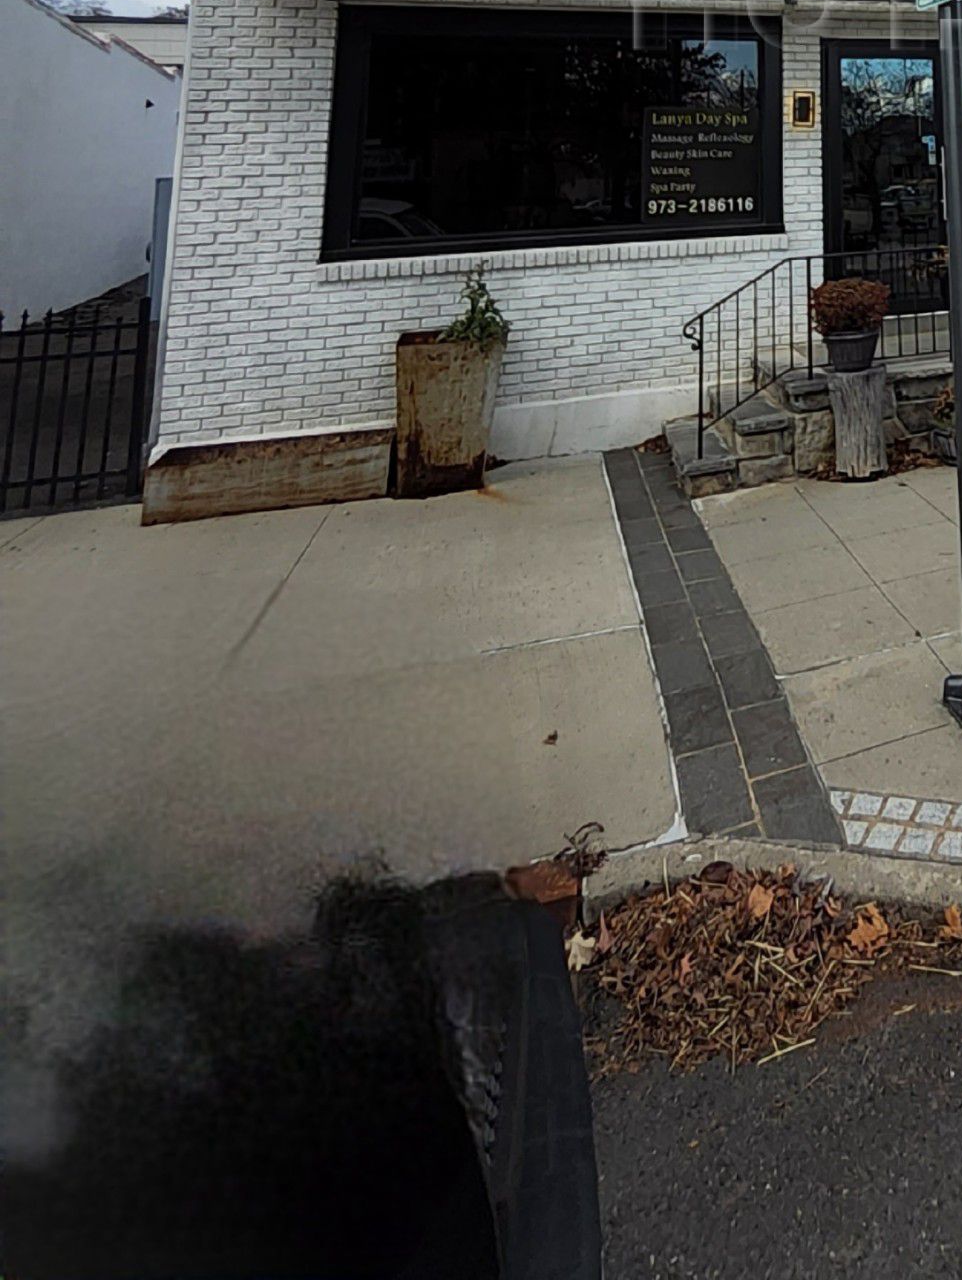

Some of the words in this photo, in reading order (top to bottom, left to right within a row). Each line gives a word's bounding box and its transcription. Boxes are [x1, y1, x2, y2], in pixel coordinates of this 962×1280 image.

[652, 113, 692, 127] Lanya
[696, 113, 722, 127] Day
[724, 113, 748, 127] Spa
[651, 149, 685, 161] Beauty
[687, 148, 708, 159] Skin
[710, 148, 733, 159] Care
[651, 166, 691, 177] Waxing
[648, 197, 754, 214] 973-2186116
